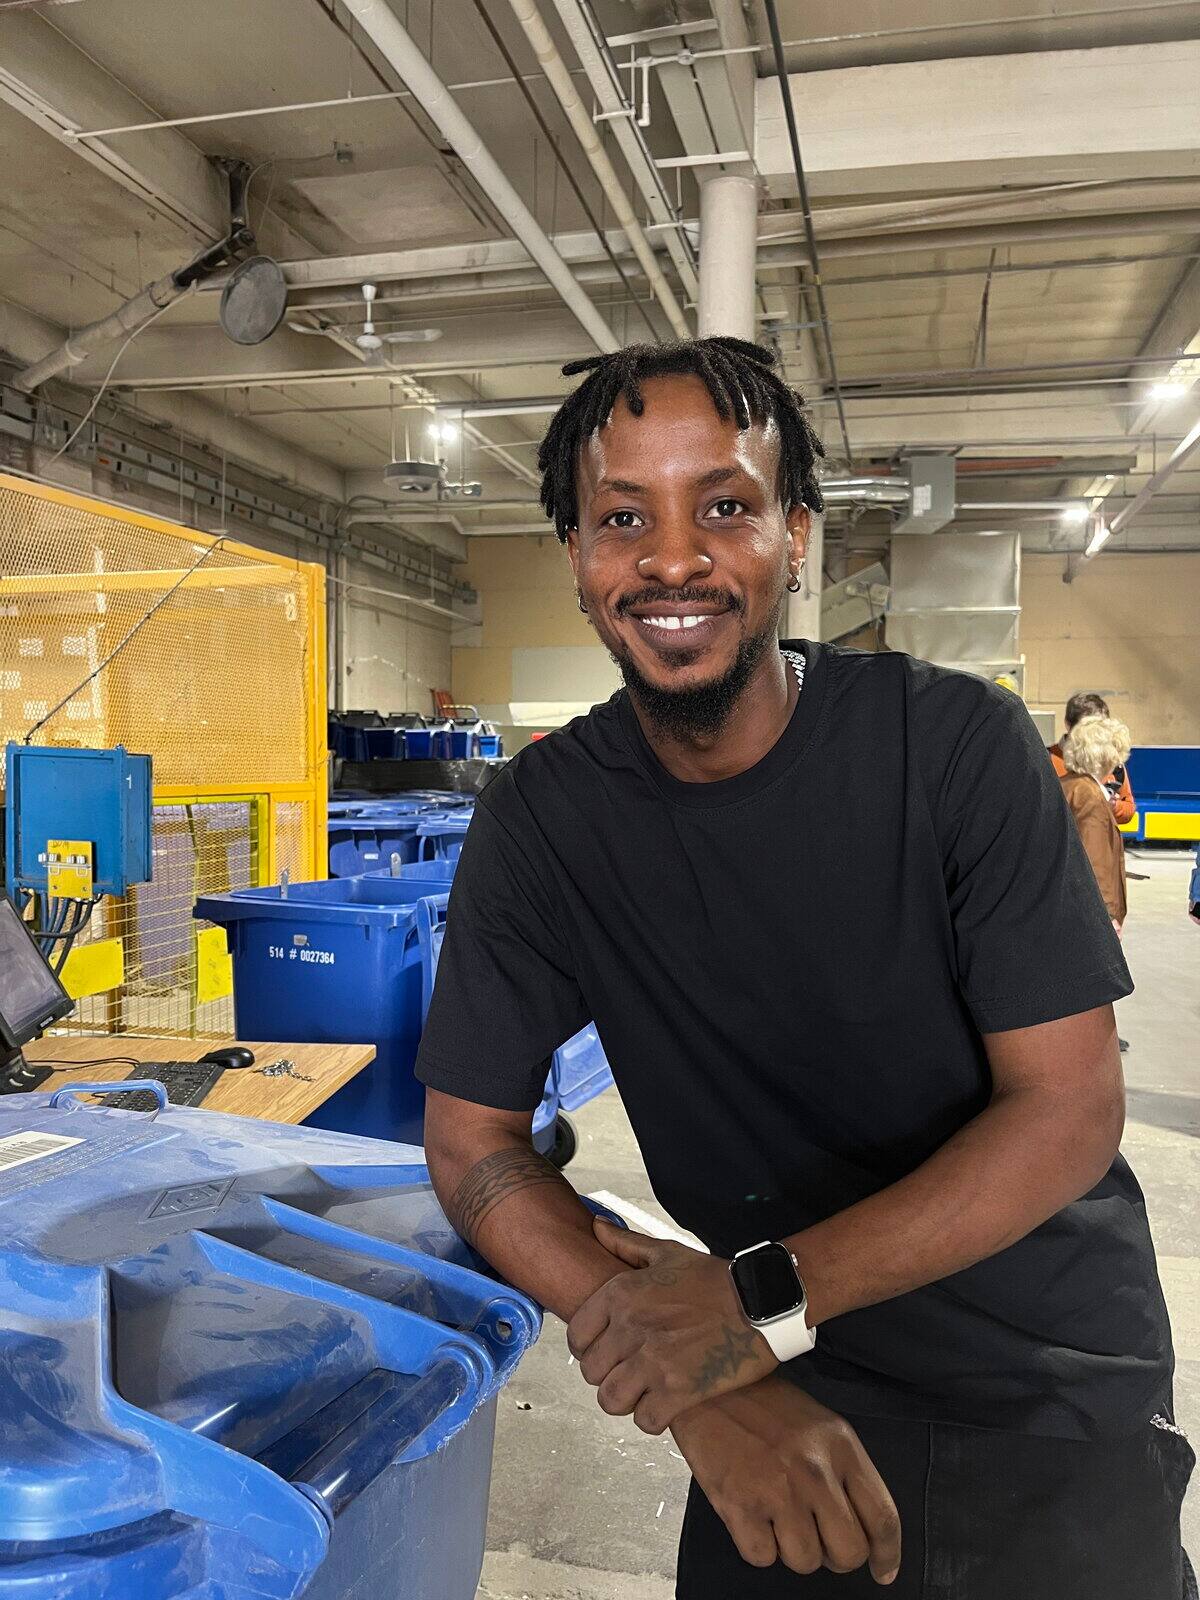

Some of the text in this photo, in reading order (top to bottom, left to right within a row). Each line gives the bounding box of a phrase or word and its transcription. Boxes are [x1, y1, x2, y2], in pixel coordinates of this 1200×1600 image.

[269, 945, 335, 964] 514 # 0027364
